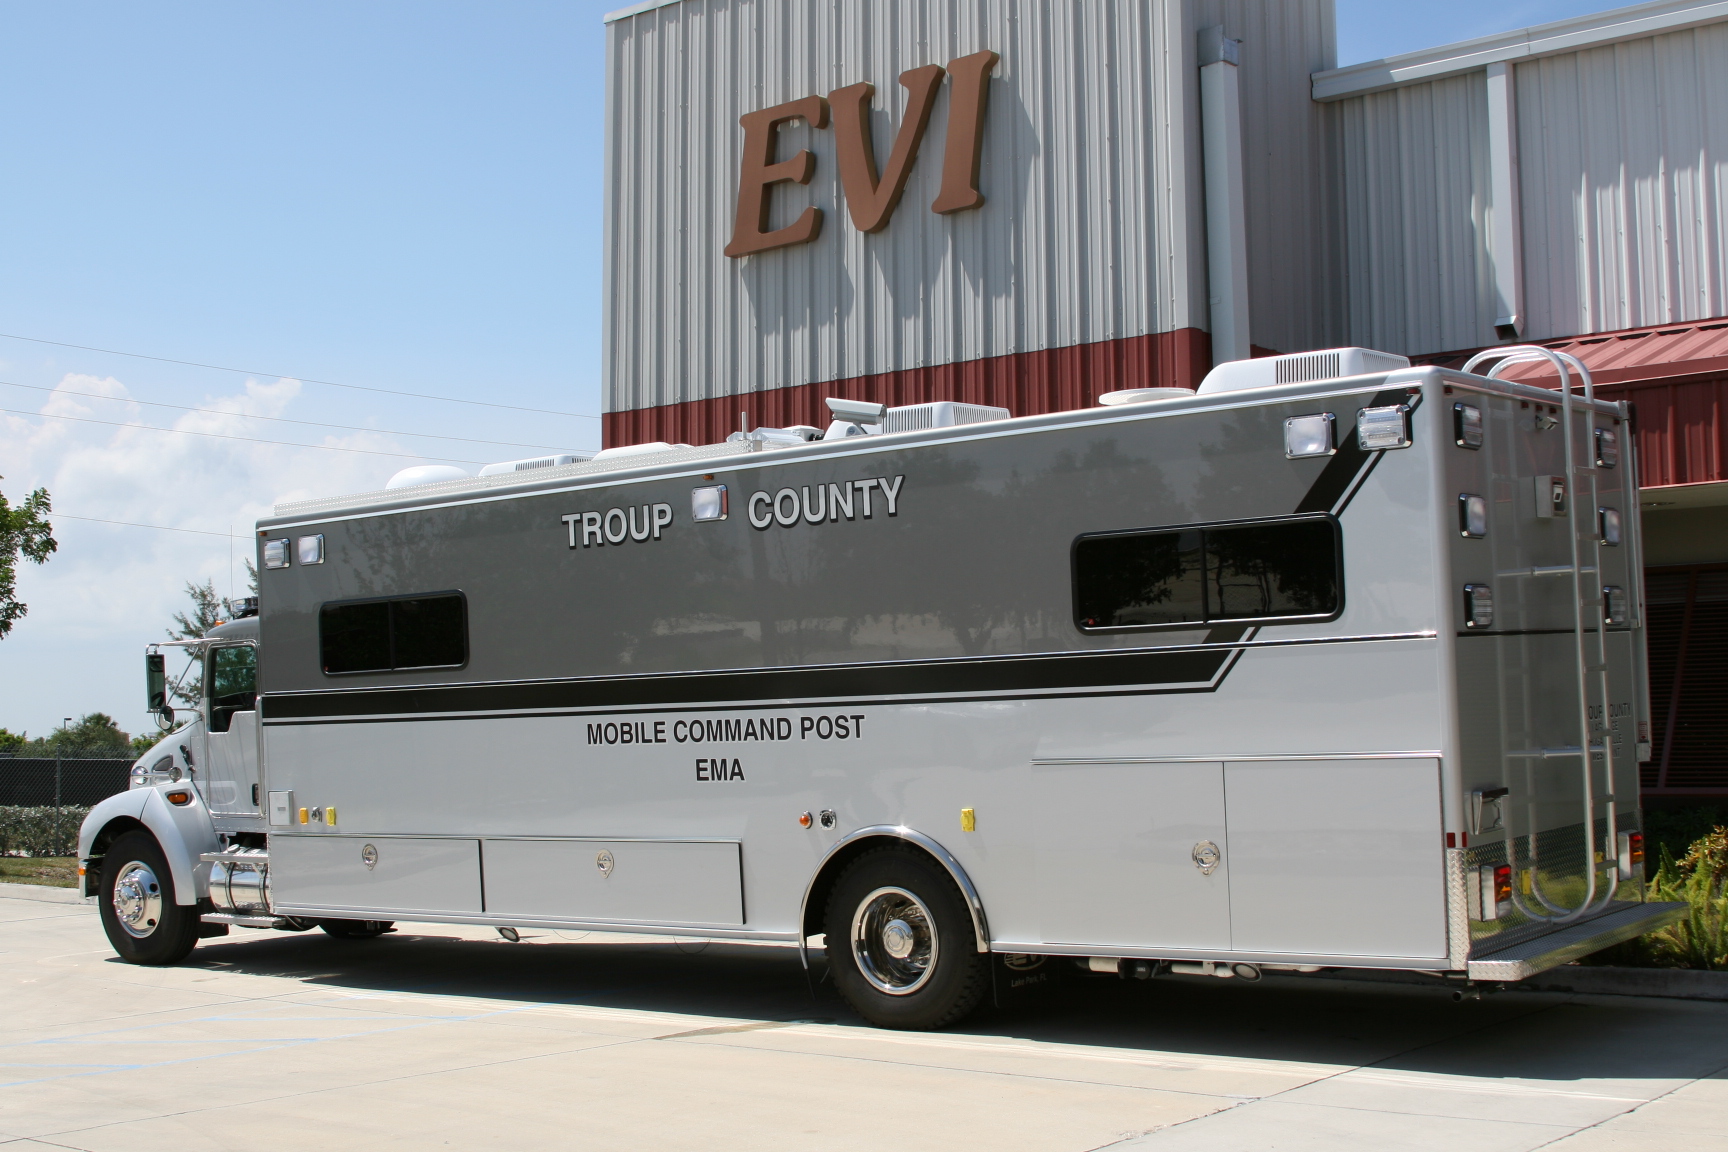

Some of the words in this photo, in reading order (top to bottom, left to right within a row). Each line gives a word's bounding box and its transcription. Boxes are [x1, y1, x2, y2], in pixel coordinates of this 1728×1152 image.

[724, 49, 1000, 259] EVI
[561, 502, 674, 549] TROUP
[748, 475, 905, 530] COUNTY
[1609, 702, 1632, 718] OUNTY
[586, 720, 668, 745] MOBILE
[673, 717, 793, 744] COMMAND
[800, 714, 866, 741] POST
[695, 757, 746, 782] EMA
[1011, 977, 1025, 988] Lake
[1039, 972, 1048, 982] FL
